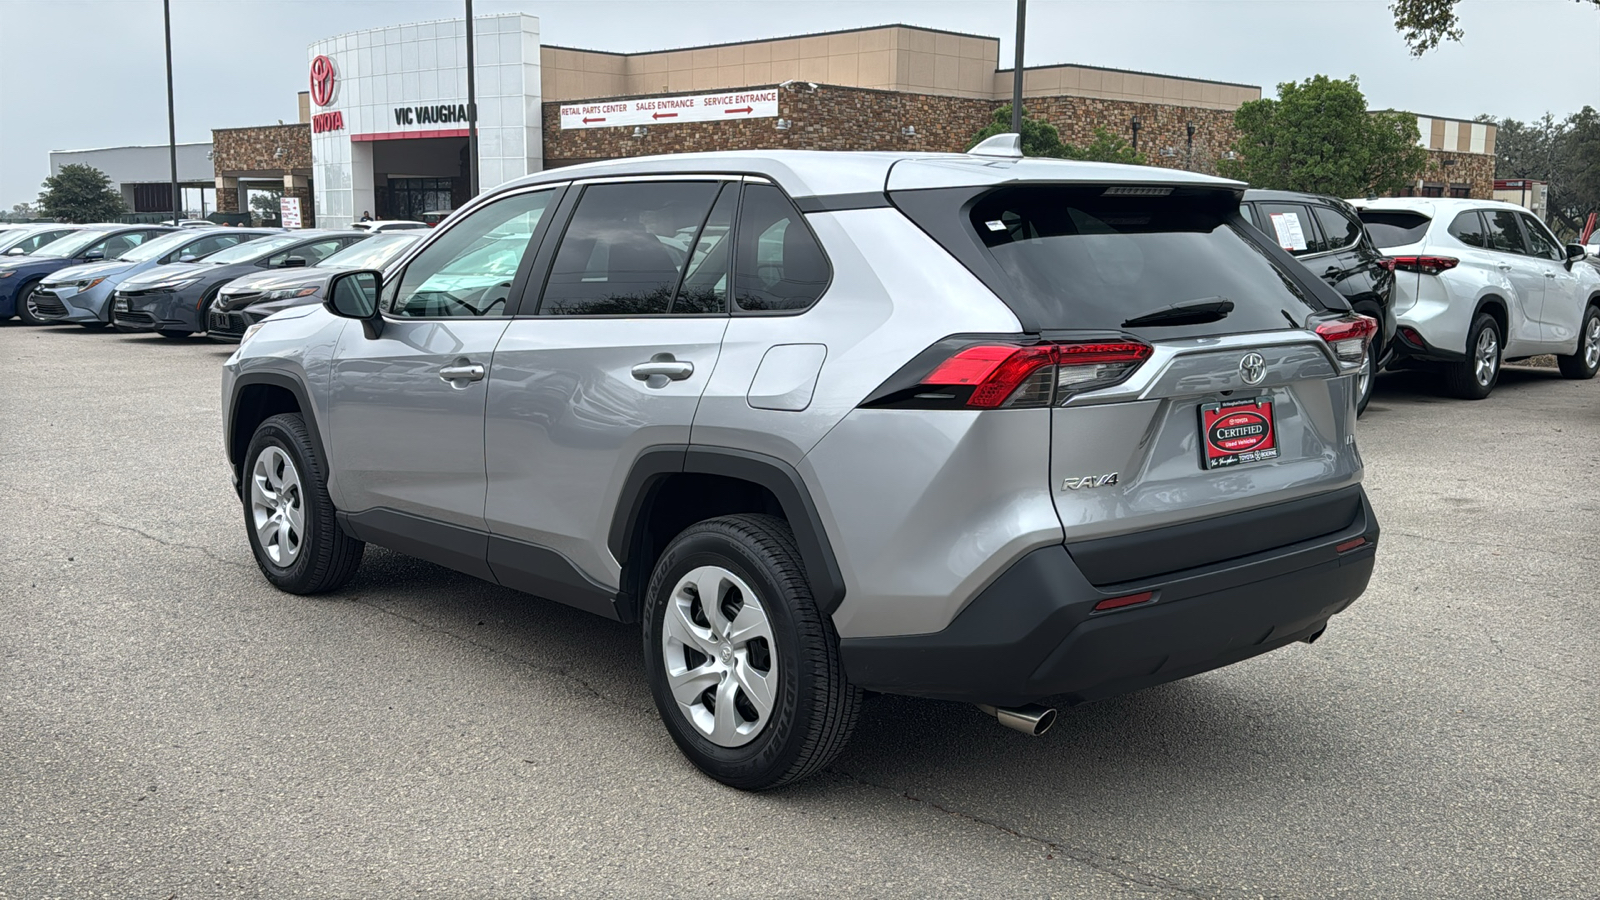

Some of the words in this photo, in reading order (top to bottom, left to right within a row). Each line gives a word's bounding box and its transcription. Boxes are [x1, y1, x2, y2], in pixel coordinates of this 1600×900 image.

[636, 101, 656, 111] SALES
[657, 98, 694, 110] ENTRANCE
[704, 95, 733, 107] SERVICE
[735, 92, 777, 104] ENTRANCE
[394, 107, 413, 125] VIC
[561, 105, 581, 116] RETAIL
[582, 104, 601, 115] PARTS
[602, 103, 628, 114] CENTER
[312, 110, 344, 133] TOYOTA
[1061, 472, 1118, 491] RAV4
[645, 550, 677, 626] DUNLOP
